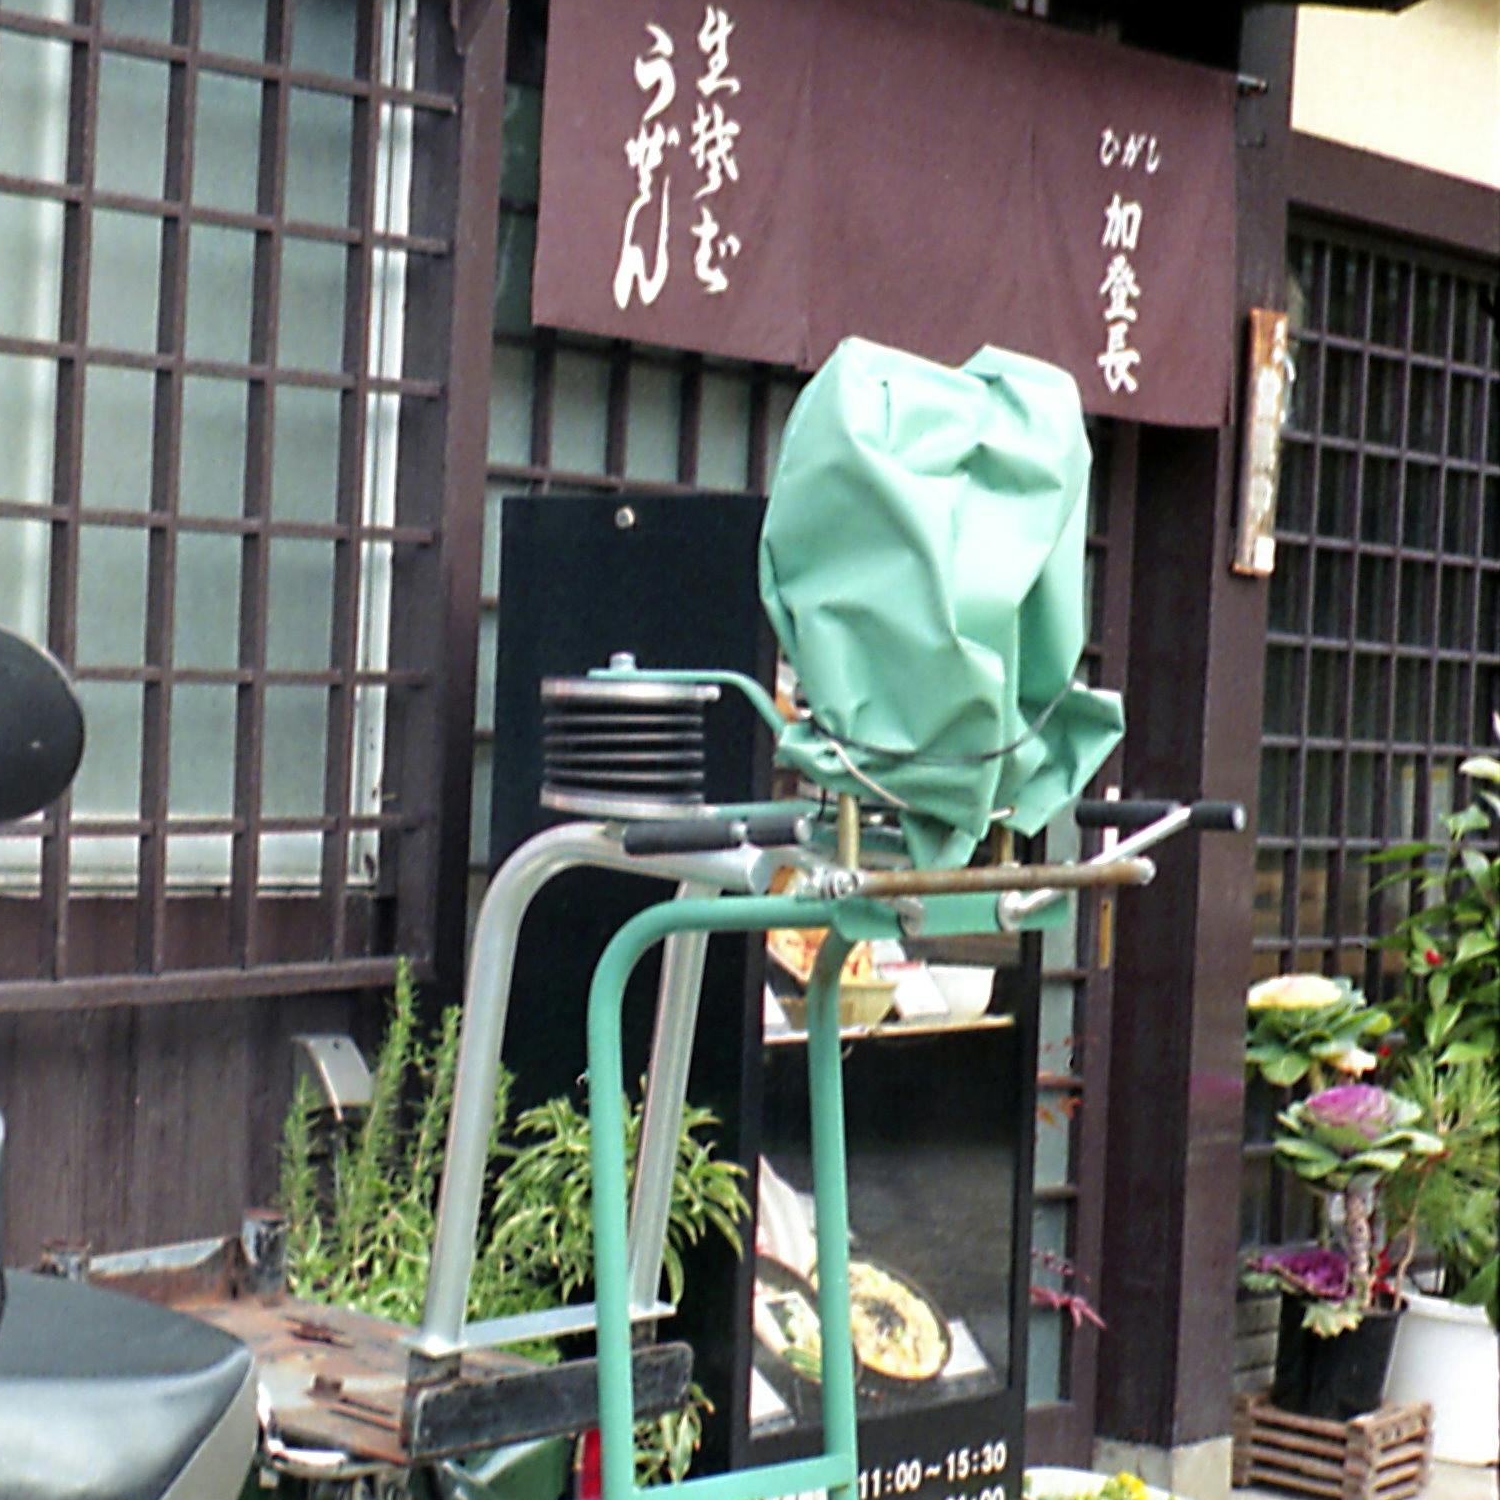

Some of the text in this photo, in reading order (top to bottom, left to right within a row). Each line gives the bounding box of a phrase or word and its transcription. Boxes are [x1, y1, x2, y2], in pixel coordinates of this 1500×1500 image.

[1099, 127, 1161, 174] ひがし
[1096, 192, 1143, 393] 加登長
